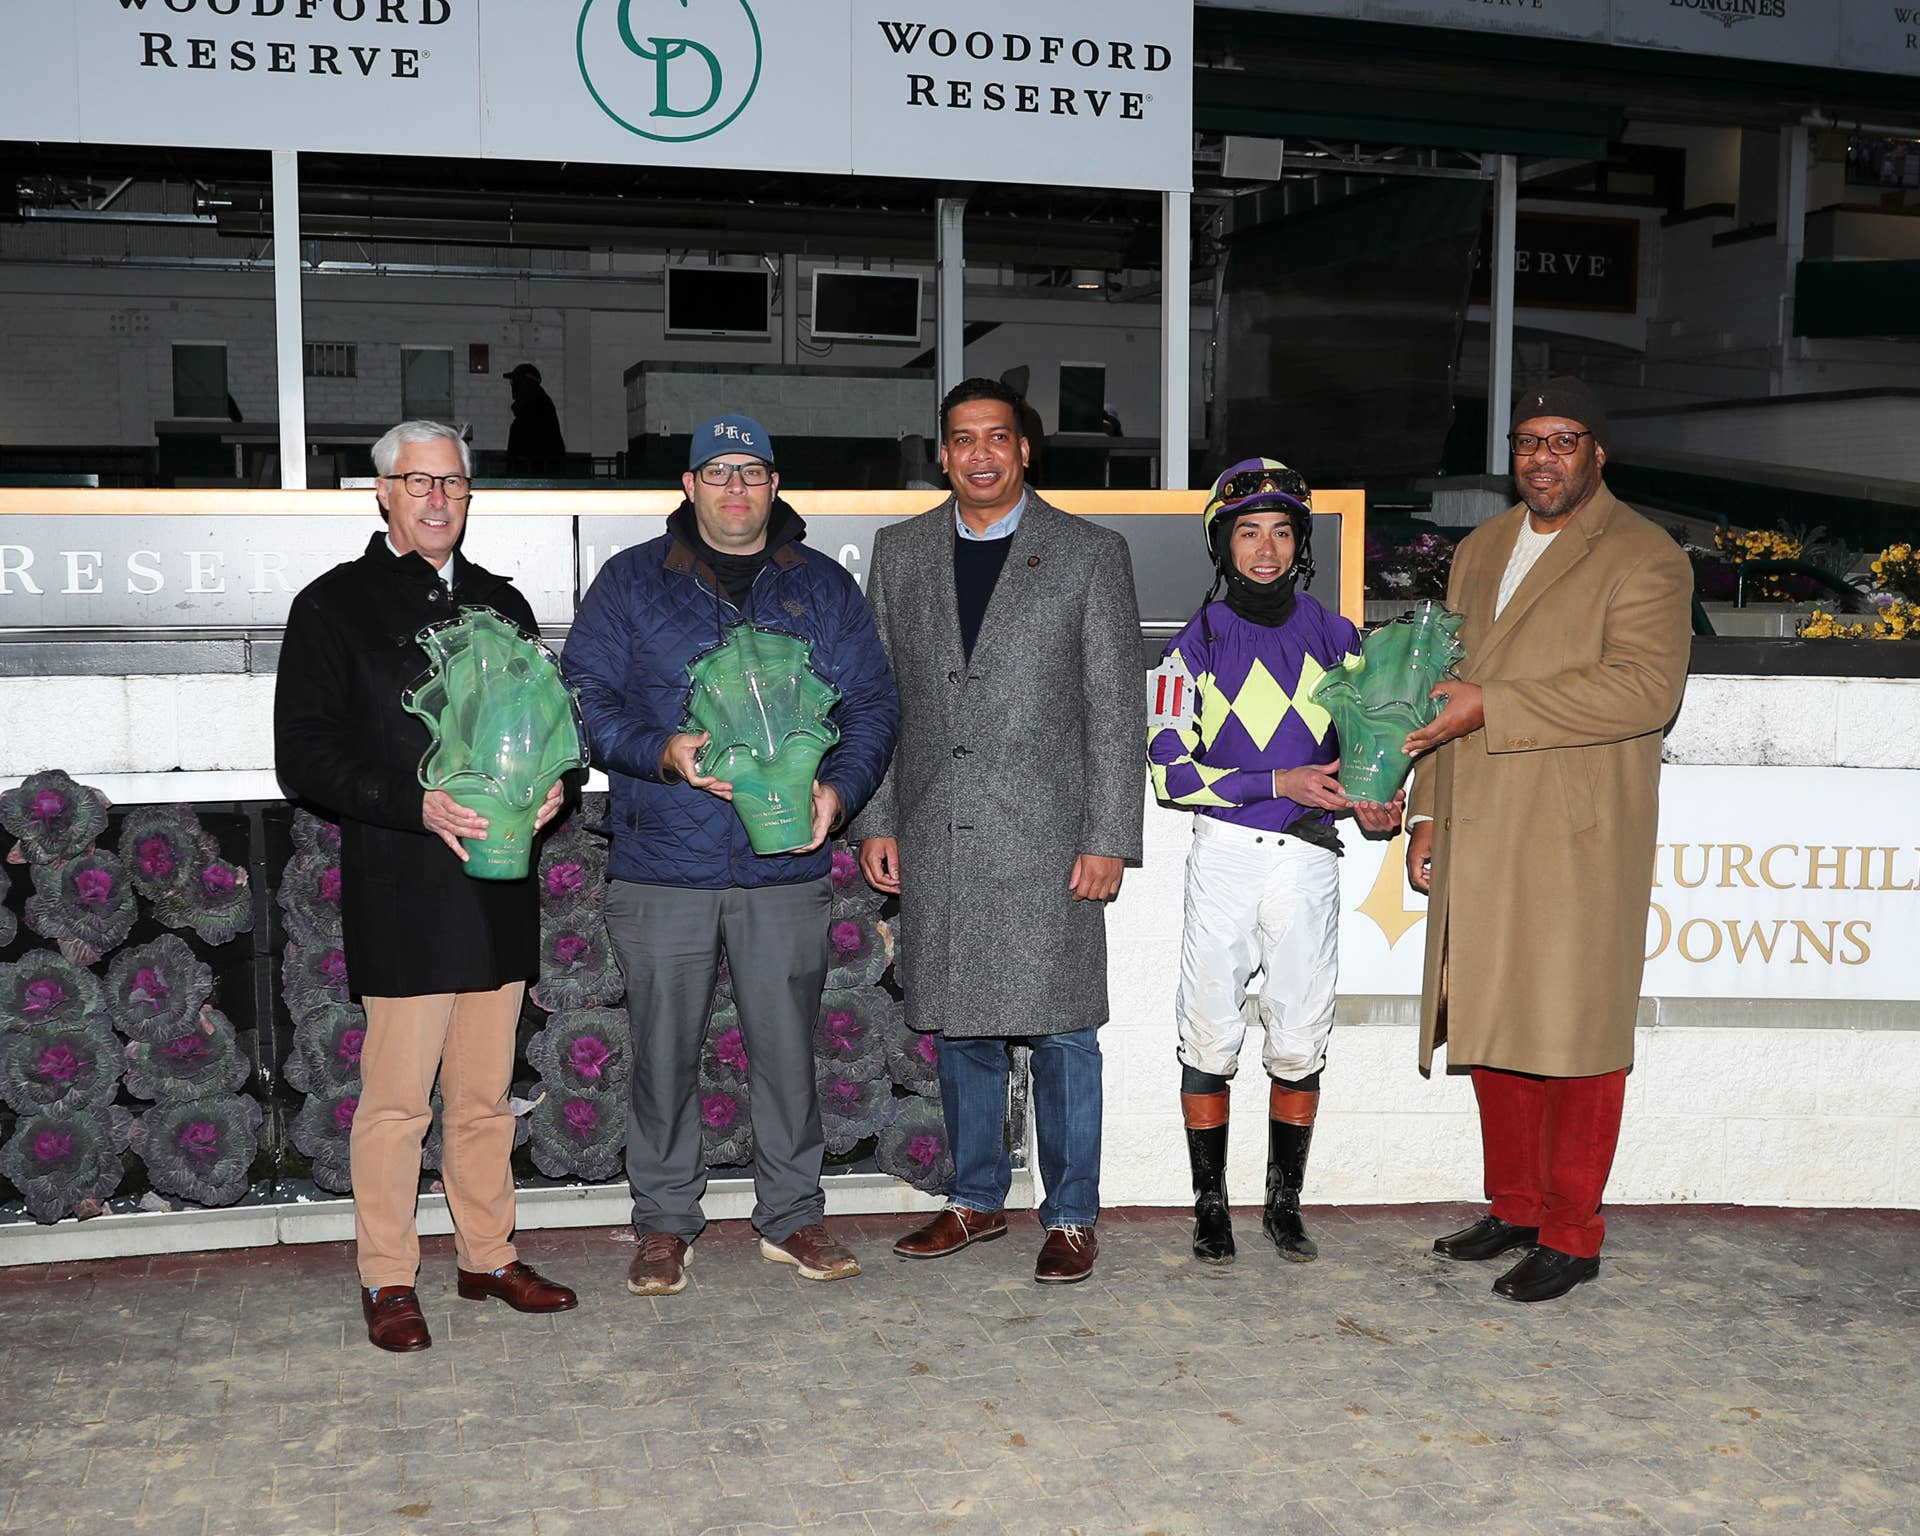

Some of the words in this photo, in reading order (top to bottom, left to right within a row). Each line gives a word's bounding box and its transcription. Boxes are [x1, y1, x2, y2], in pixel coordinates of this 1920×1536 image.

[140, 33, 419, 79] RESERVE
[878, 21, 1172, 72] WOODFORD
[907, 74, 1144, 120] RESERVE
